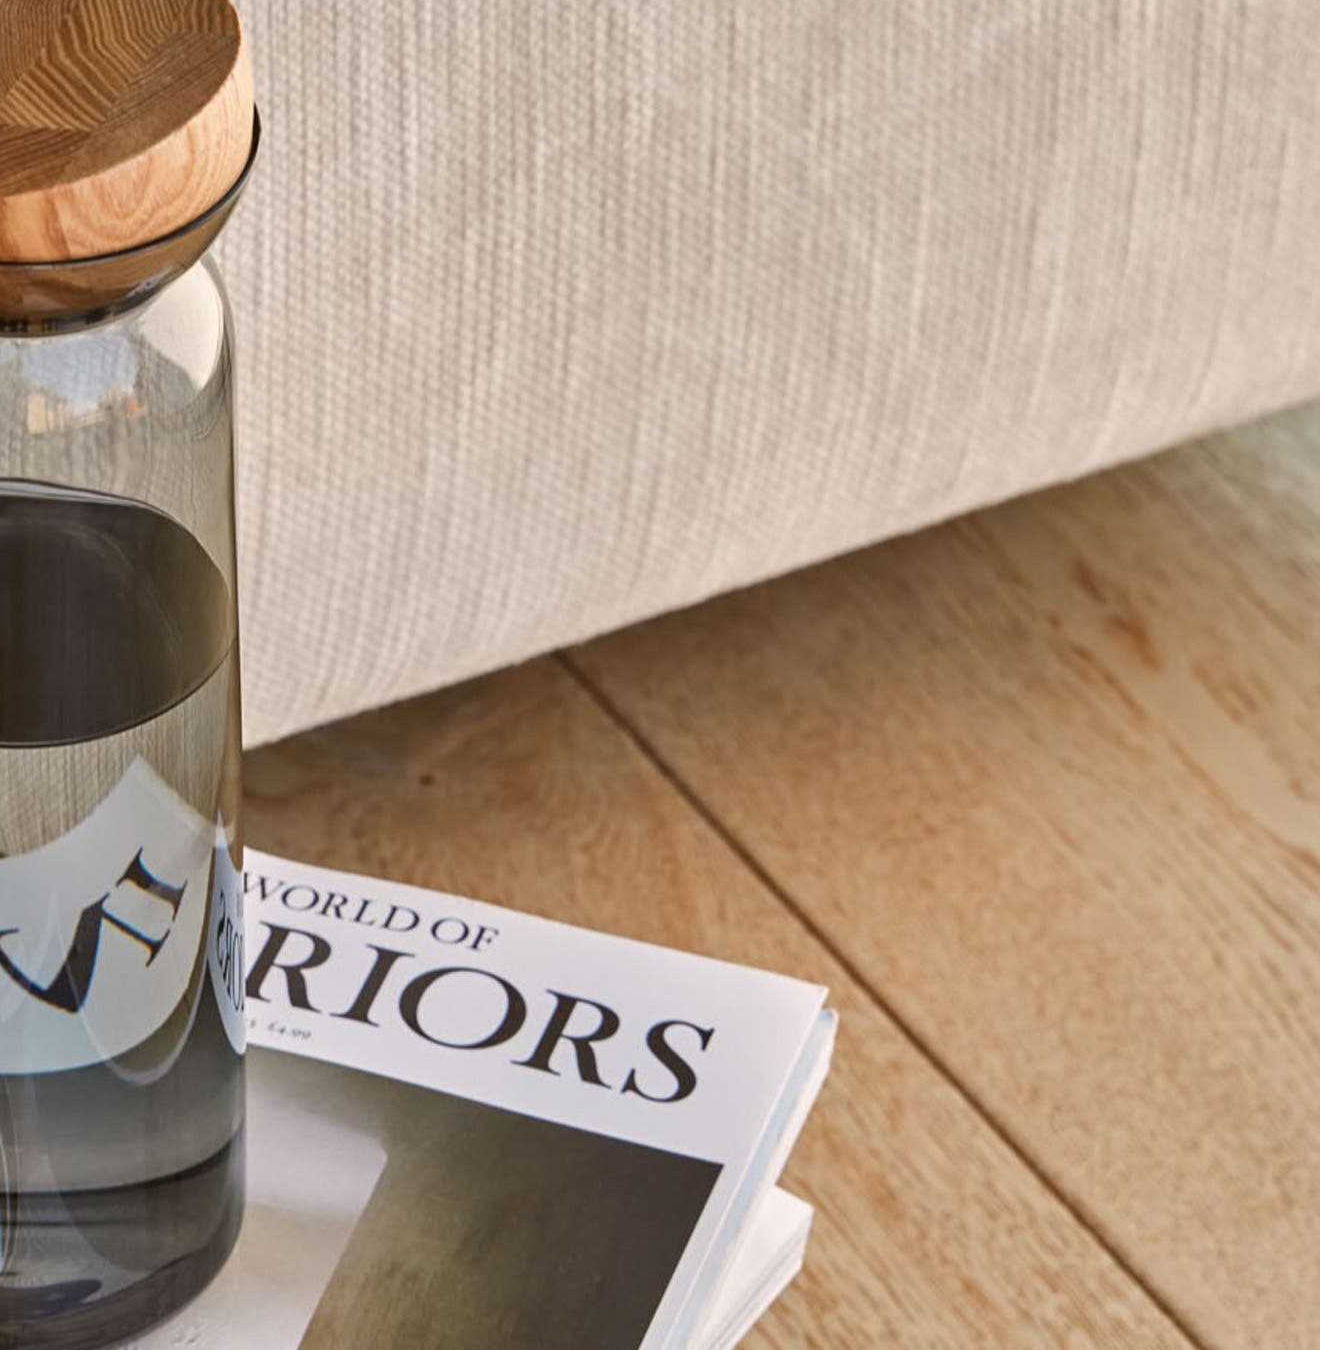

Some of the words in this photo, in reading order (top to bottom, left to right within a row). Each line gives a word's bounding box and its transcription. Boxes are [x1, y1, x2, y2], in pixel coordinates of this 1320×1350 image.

[242, 871, 421, 933] WORLD
[429, 916, 500, 951] OF
[244, 919, 715, 1104] RIORS
